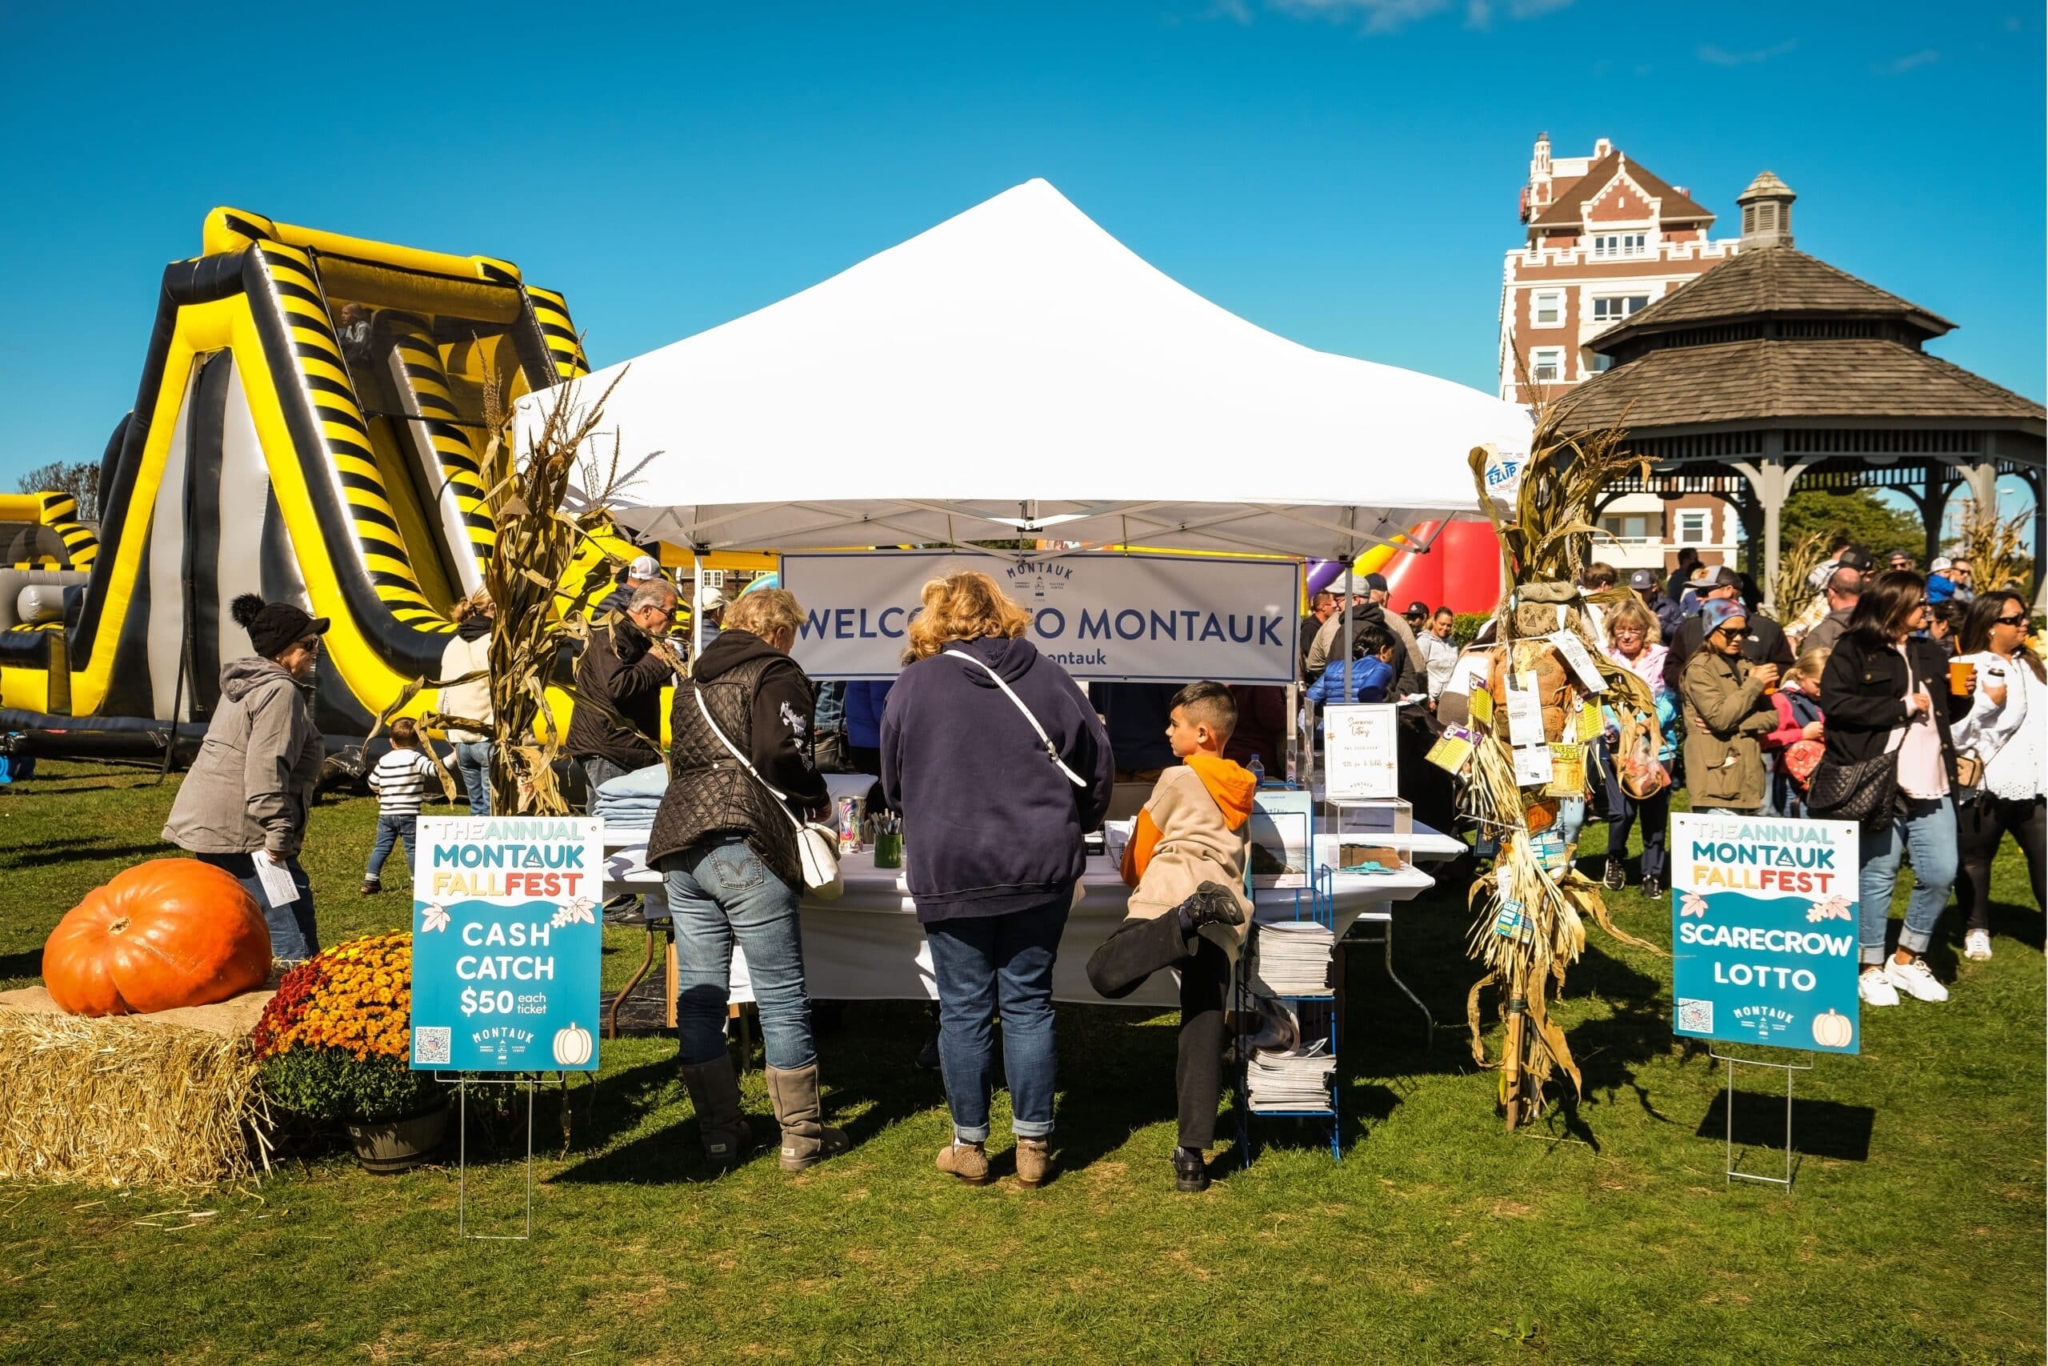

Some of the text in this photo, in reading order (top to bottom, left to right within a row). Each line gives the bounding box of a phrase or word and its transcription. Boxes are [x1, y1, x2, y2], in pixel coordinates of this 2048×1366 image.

[1006, 562, 1073, 580] MONTAUK
[1077, 607, 1285, 647] MONTAUK
[433, 843, 585, 869] MONTAUK
[1692, 840, 1836, 870] MONTAUK
[462, 922, 551, 947] CASH
[1679, 921, 1854, 958] SCARECROW
[455, 955, 555, 981] CATCH
[1713, 961, 1817, 992] LOTTO
[460, 986, 515, 1018] $50
[517, 1003, 547, 1015] ticket
[518, 993, 547, 1004] each
[1733, 1005, 1795, 1024] MONTAUK
[472, 1026, 535, 1044] MONTAUK
